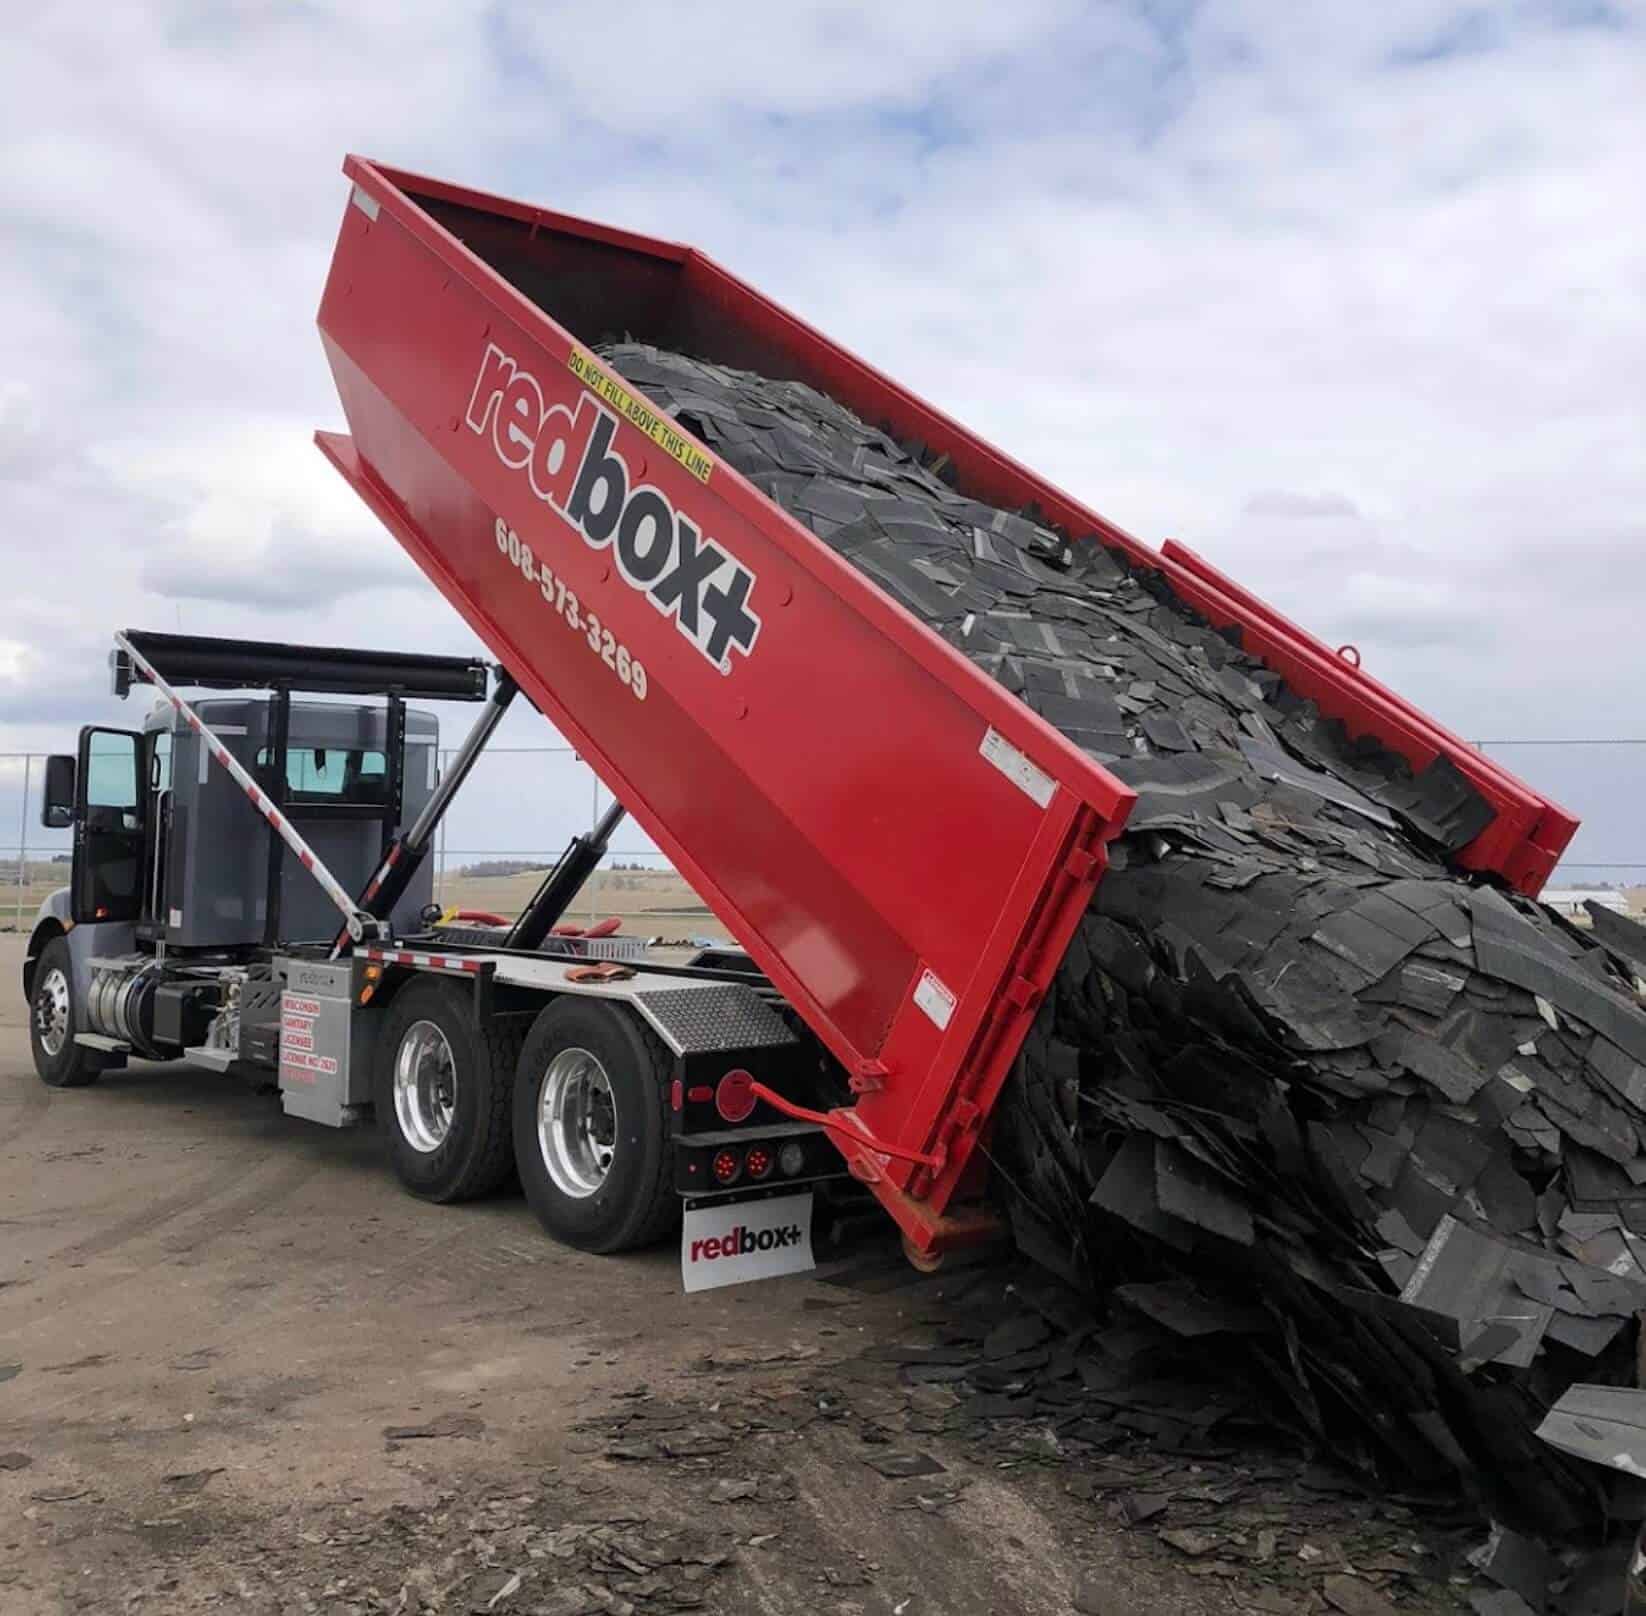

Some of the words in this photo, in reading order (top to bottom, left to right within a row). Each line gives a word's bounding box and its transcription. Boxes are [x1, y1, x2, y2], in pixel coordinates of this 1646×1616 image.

[569, 352, 583, 373] DO
[583, 364, 604, 389] NOT
[604, 383, 623, 409] FILL
[625, 401, 659, 436] ABOVE
[660, 428, 684, 458] THIS
[685, 447, 711, 481] LINE
[495, 517, 648, 701] 608-573-3269
